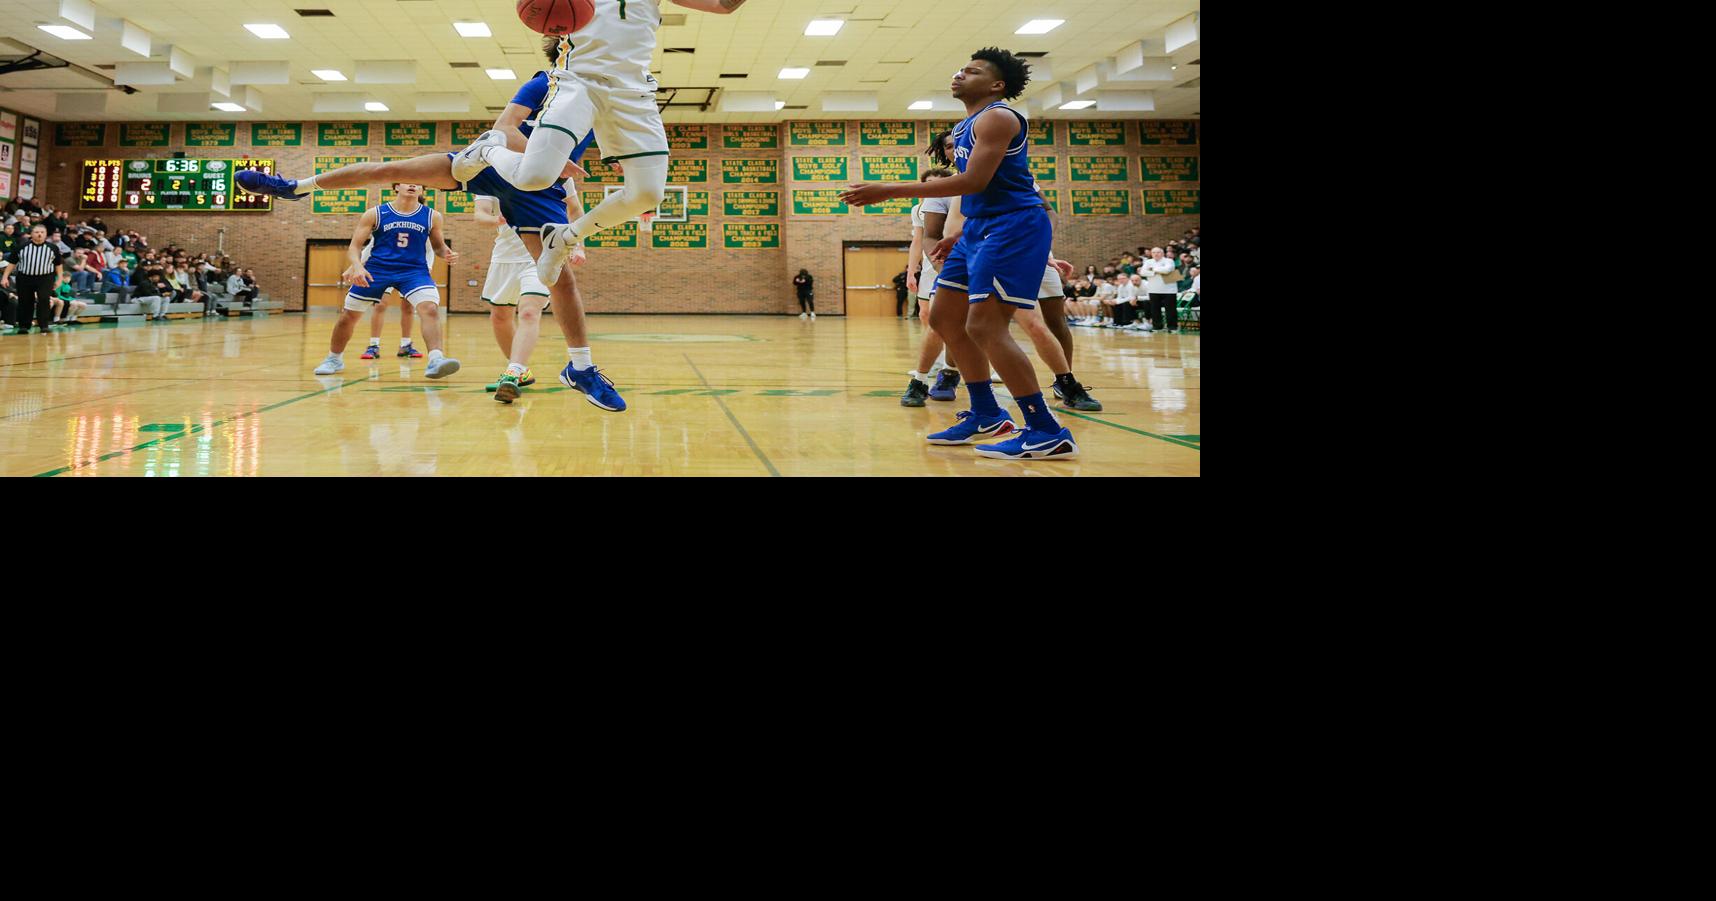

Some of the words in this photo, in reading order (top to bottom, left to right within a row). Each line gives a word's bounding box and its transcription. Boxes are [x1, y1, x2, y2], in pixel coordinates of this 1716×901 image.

[166, 160, 198, 172] 6:36
[141, 179, 151, 190] 2
[172, 180, 180, 190] 2
[212, 180, 225, 190] 16
[130, 194, 138, 204] 0
[146, 195, 154, 204] 4
[196, 195, 205, 204] 5
[216, 194, 224, 204] 0
[384, 221, 426, 233] ROCKHURST
[396, 232, 410, 248] 5
